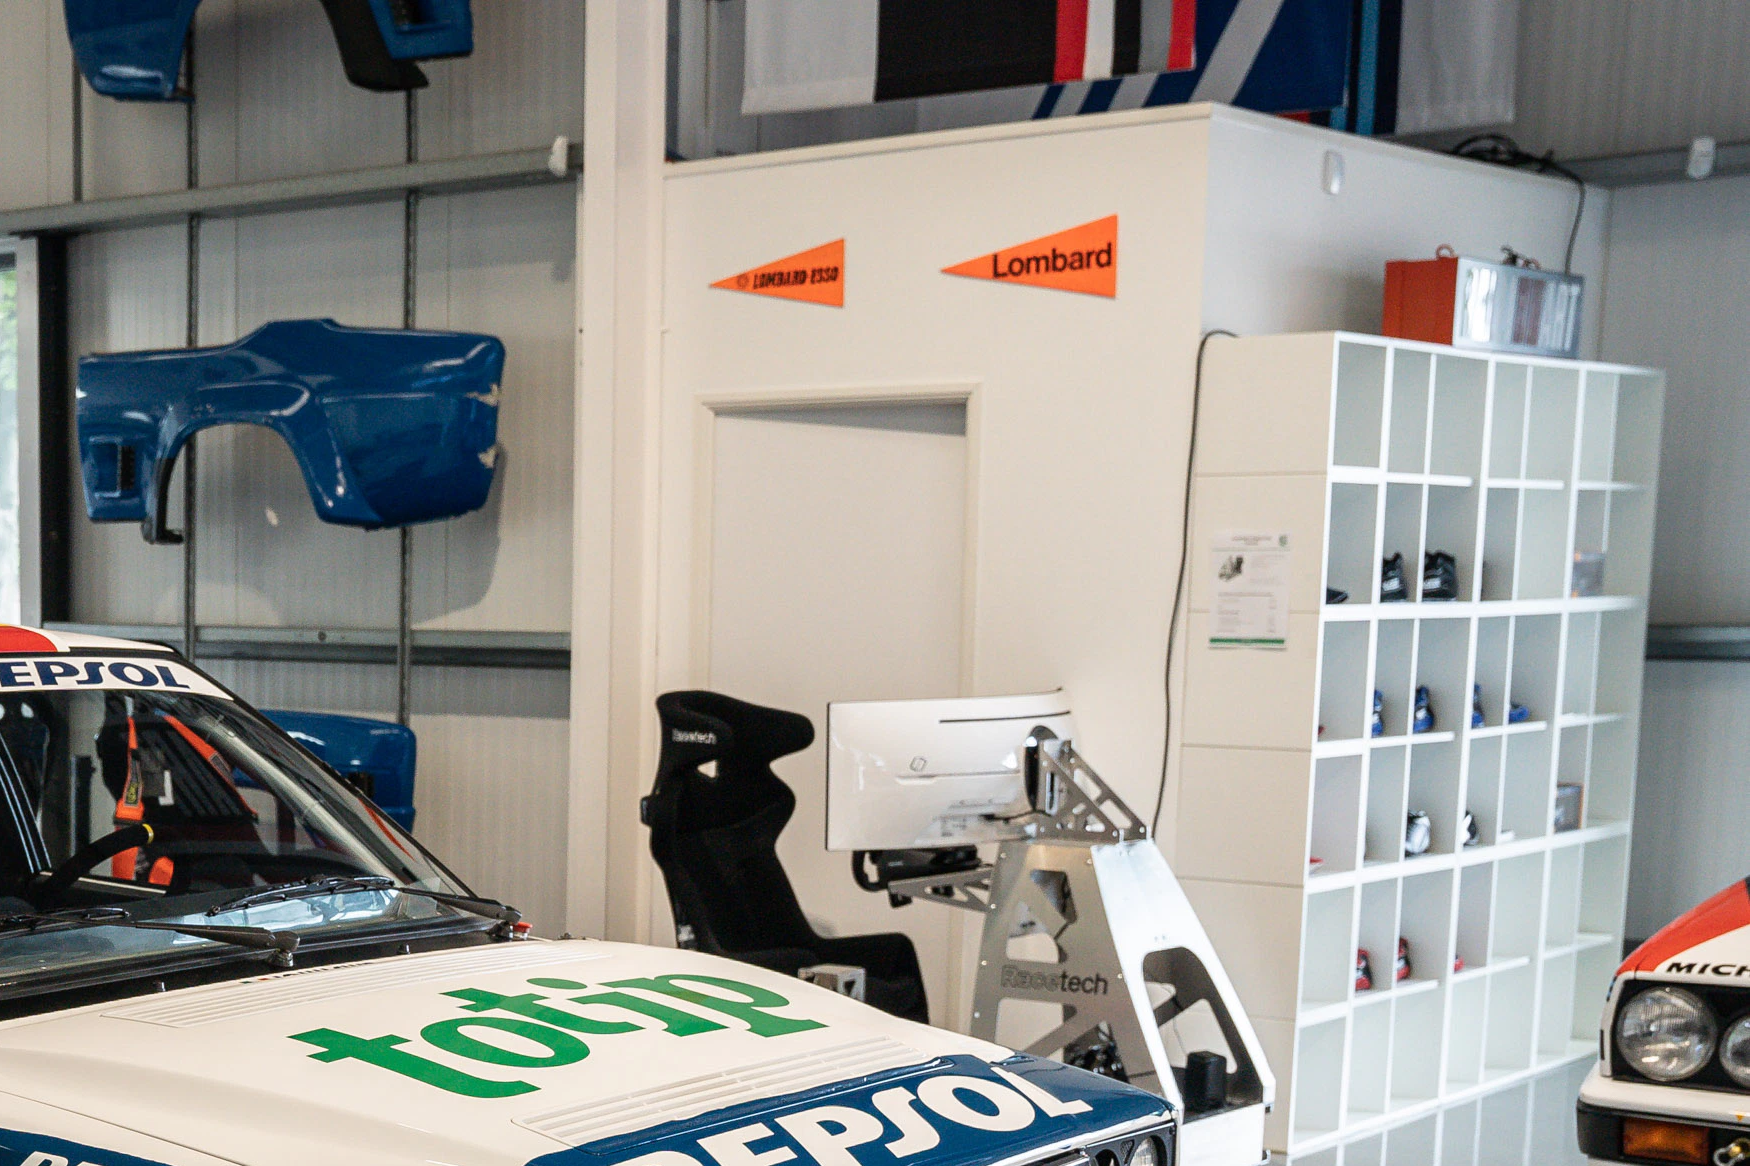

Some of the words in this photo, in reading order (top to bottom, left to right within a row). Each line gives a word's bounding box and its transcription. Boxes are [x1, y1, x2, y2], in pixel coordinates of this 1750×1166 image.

[993, 242, 1112, 279] Lombard
[1001, 964, 1109, 995] Racetech
[288, 974, 829, 1098] totip
